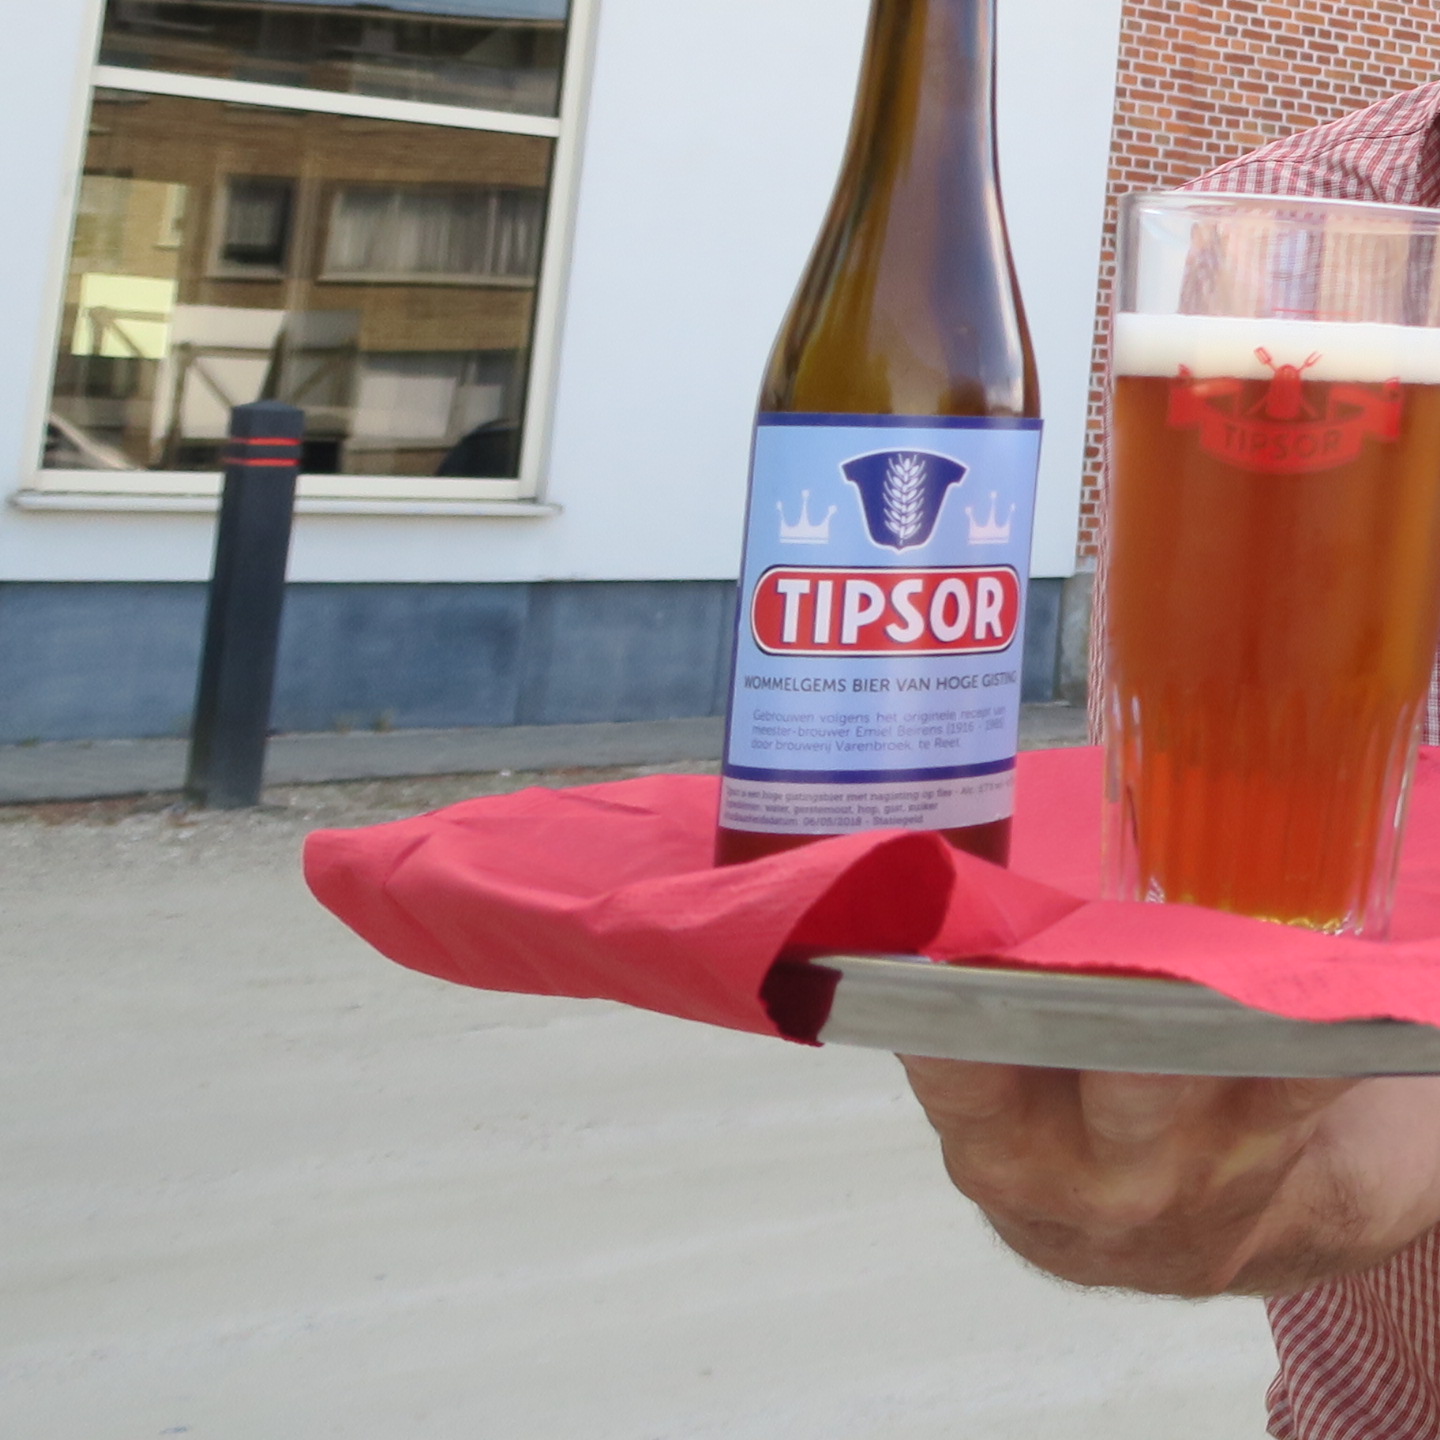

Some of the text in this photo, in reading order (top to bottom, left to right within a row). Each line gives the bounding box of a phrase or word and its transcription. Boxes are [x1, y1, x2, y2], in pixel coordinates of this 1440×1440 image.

[1224, 426, 1343, 460] TIPSOR
[777, 577, 1004, 644] TIPSOR
[744, 675, 847, 692] WOMMELGEMS
[852, 678, 890, 692] BIER
[897, 677, 931, 691] VAN
[936, 675, 979, 690] HOGE
[753, 709, 815, 722] Gebrouwen
[820, 713, 870, 726] volgens
[876, 712, 897, 722] het
[856, 726, 892, 738] Emiel
[897, 725, 943, 737] Beirens
[775, 740, 831, 755] brouwerij
